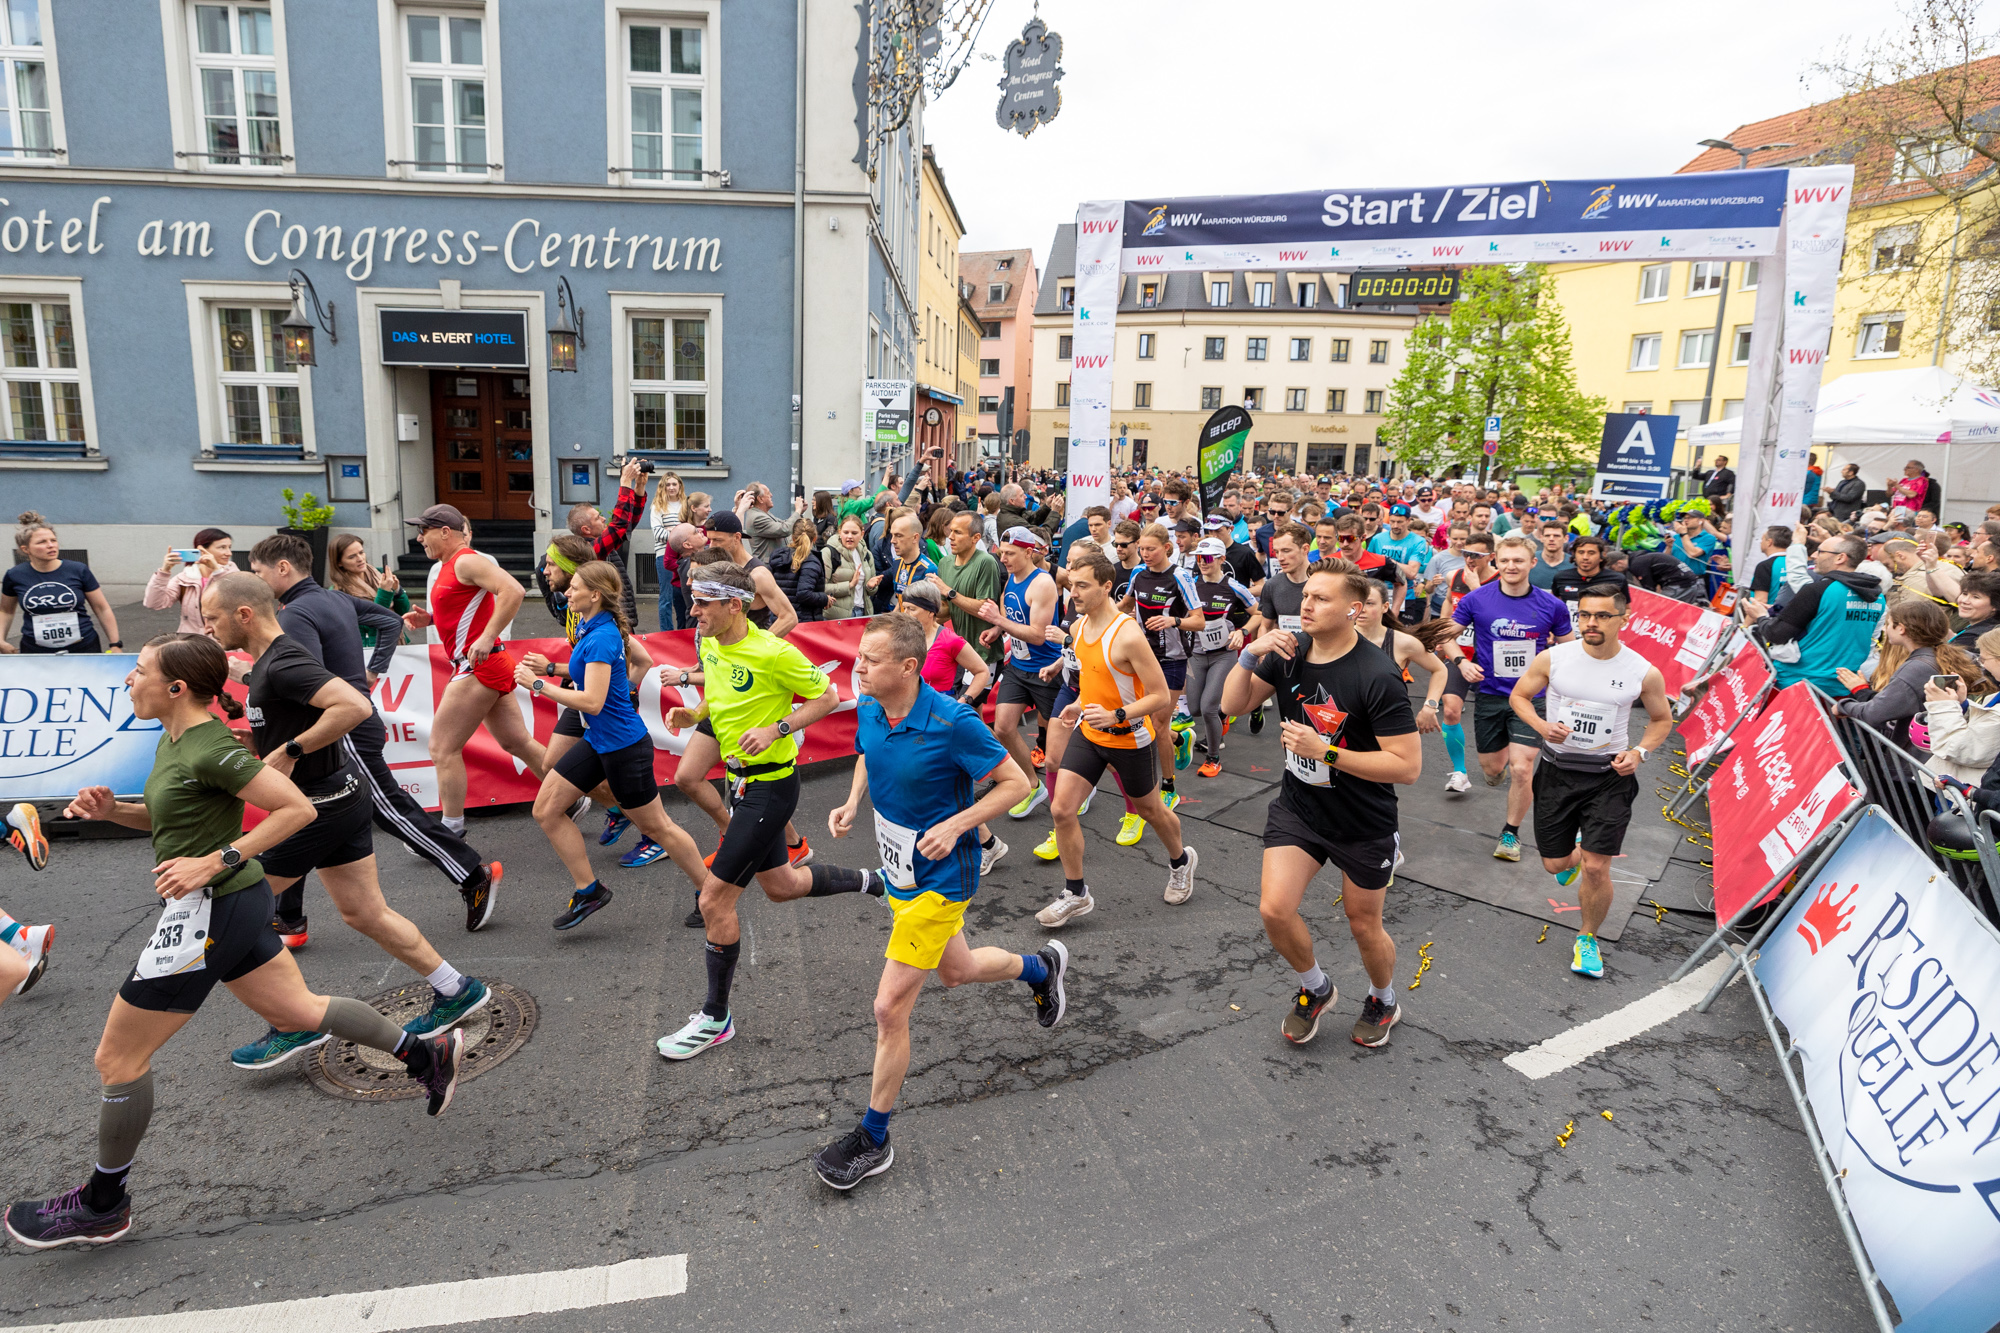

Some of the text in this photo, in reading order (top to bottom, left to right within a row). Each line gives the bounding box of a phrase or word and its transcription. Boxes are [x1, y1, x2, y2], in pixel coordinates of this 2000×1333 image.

[1020, 54, 1043, 68] Hotel
[1022, 70, 1053, 84] Congress
[1014, 90, 1044, 102] Centrum
[1618, 193, 1764, 209] WVV MARATHON WÜRZBURG
[1794, 186, 1844, 204] WVV
[1321, 185, 1539, 227] Start / Ziel
[1083, 219, 1118, 234] WVV
[1171, 213, 1288, 226] WVV MARATHON WÜRZBURG
[137, 219, 215, 258] am
[244, 209, 724, 281] Congress-Centrum
[1433, 245, 1465, 257] WVV
[1599, 240, 1634, 252] WVV
[1137, 255, 1164, 265] WVV
[1279, 251, 1308, 261] WVV
[1357, 277, 1453, 296] 00:00:00
[392, 331, 515, 344] DAS v. EVERT HOTEL
[1075, 355, 1108, 369] WVV
[1789, 349, 1824, 364] WVV
[827, 410, 837, 420] 26
[1221, 416, 1242, 433] cep
[1617, 420, 1656, 455] A
[1204, 449, 1216, 459] SUB
[1206, 449, 1234, 474] 1:30
[1072, 474, 1104, 487] WVV
[1381, 548, 1402, 559] RUN
[26, 592, 74, 609] SRC
[42, 626, 72, 640] 5084
[1206, 631, 1222, 642] 1177
[1500, 628, 1526, 638] WORLD
[1504, 656, 1526, 668] 806
[731, 669, 744, 681] 52
[1580, 712, 1603, 721] MARATHON
[1573, 719, 1597, 734] 310
[1572, 735, 1594, 744] Maximilian
[233, 756, 249, 770] GORE
[886, 836, 902, 852] MARATHON
[883, 843, 900, 870] 224
[154, 924, 184, 950] 283
